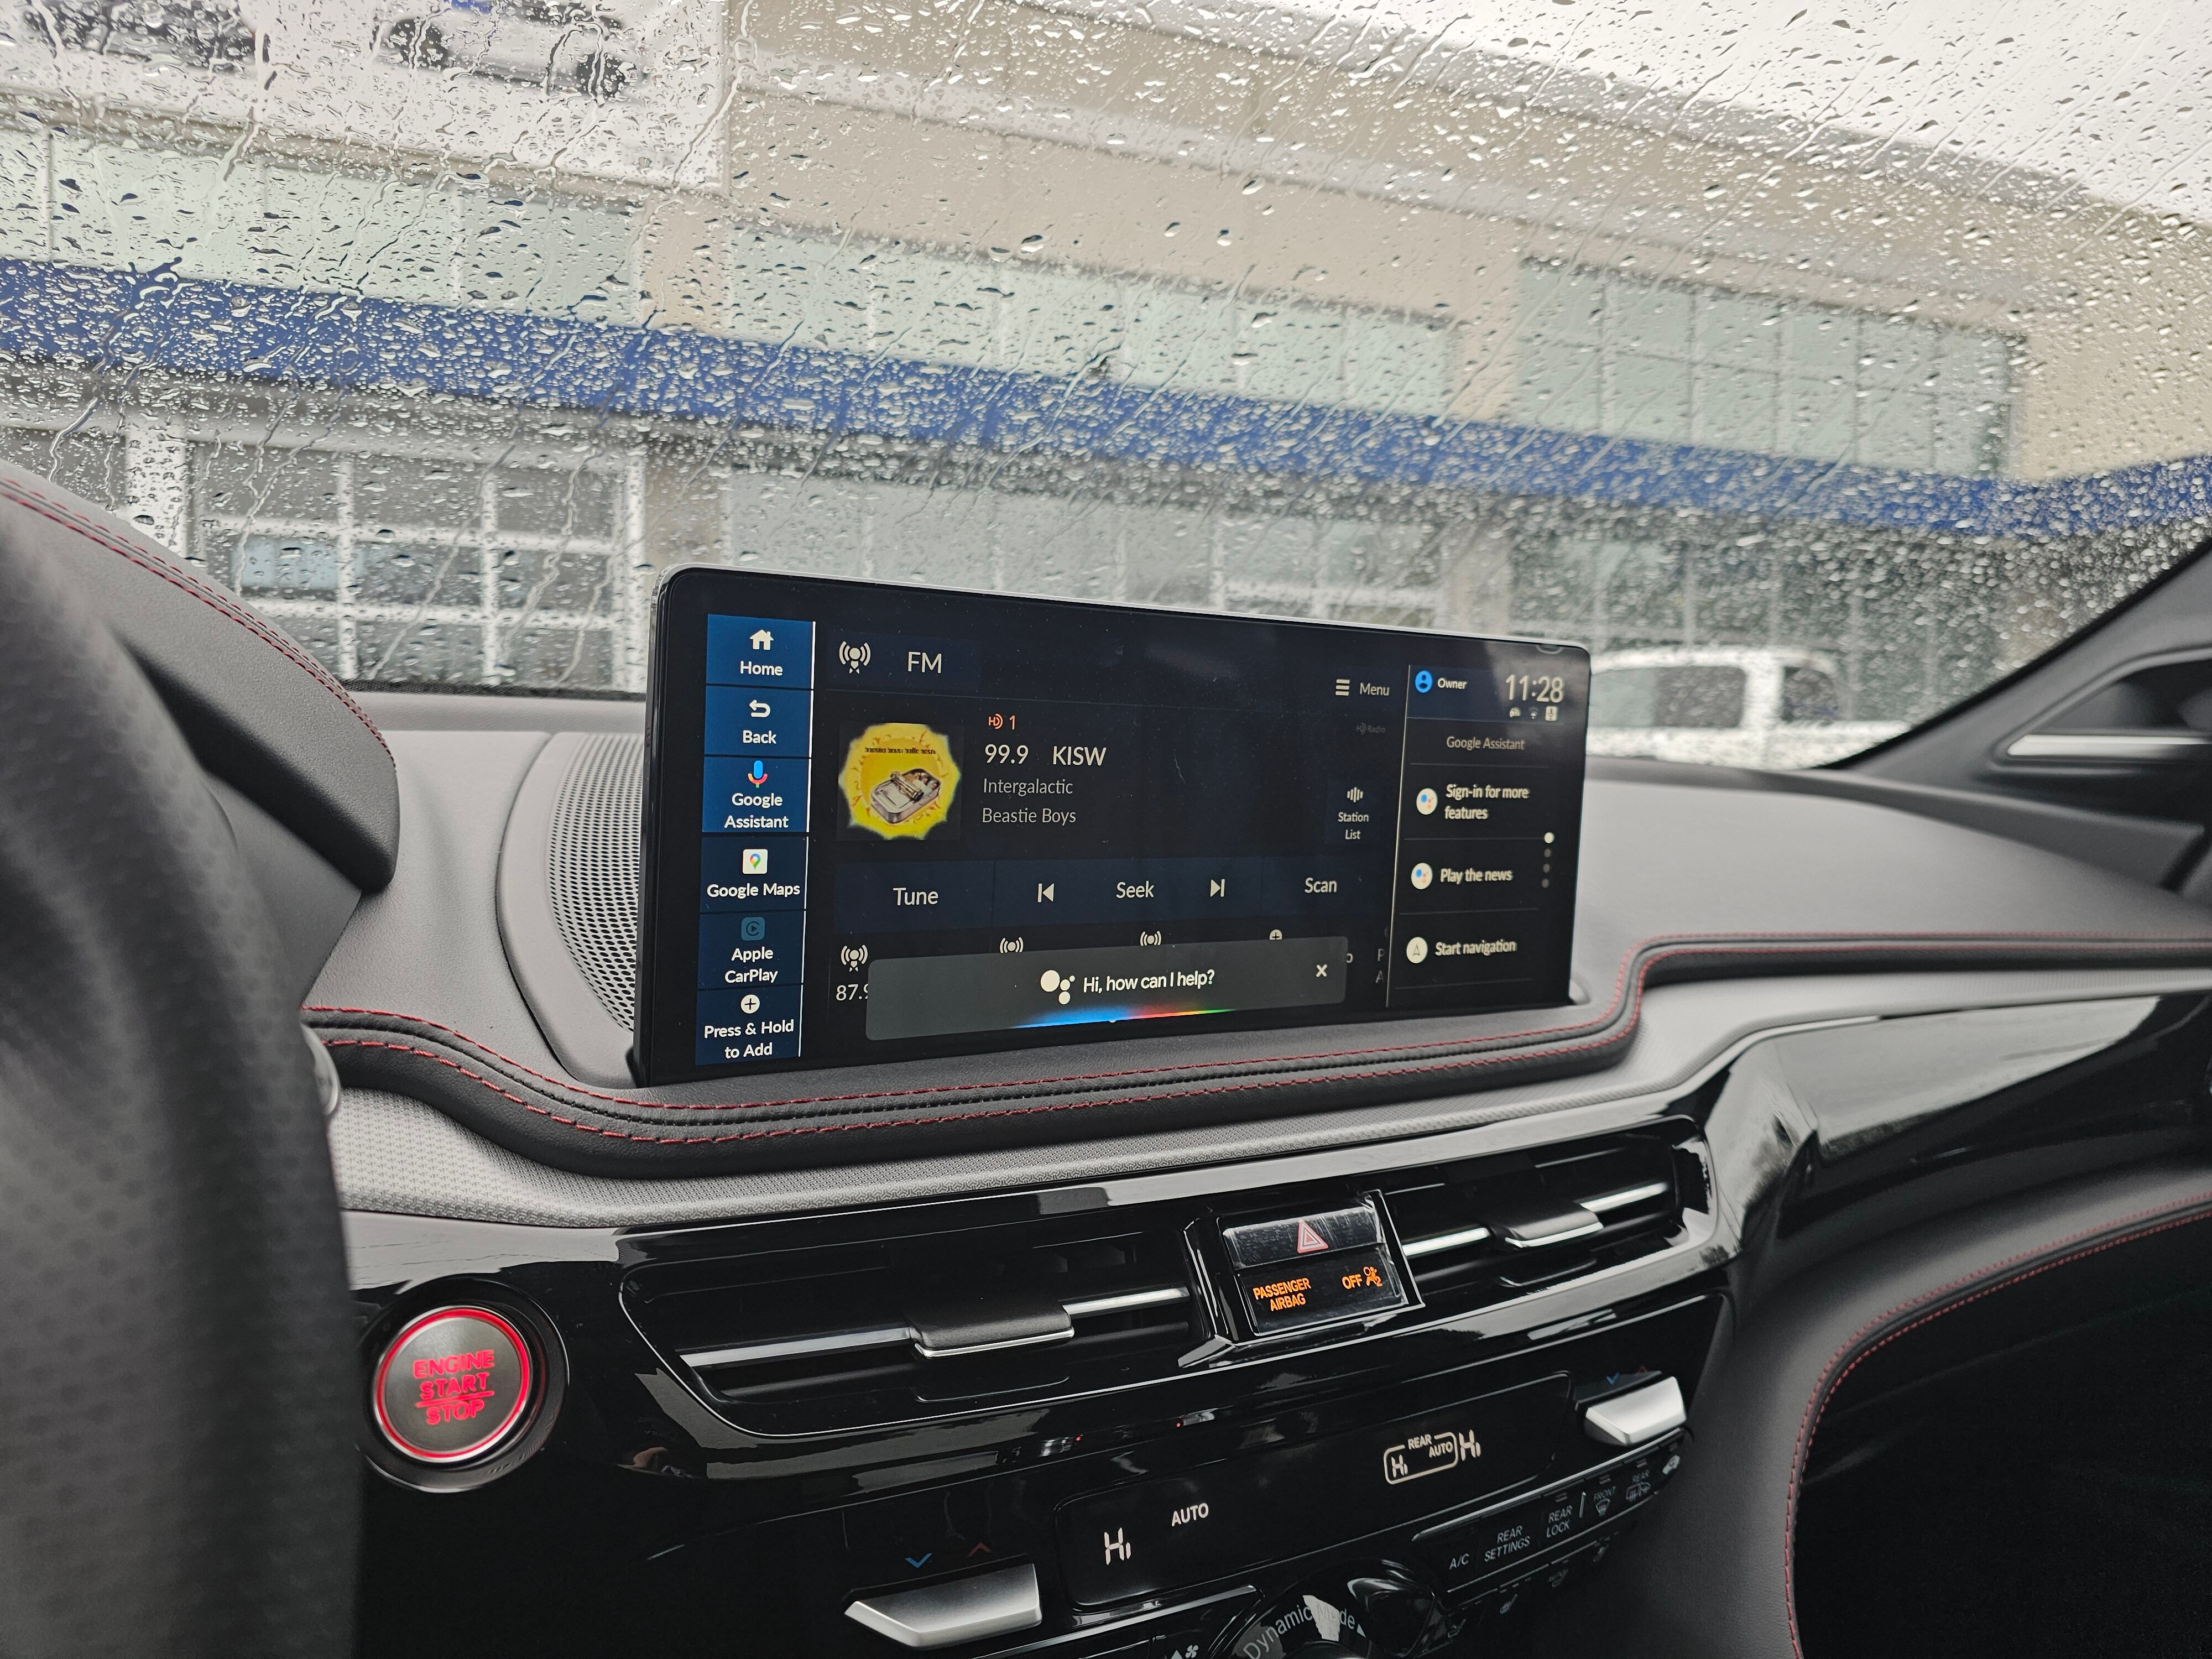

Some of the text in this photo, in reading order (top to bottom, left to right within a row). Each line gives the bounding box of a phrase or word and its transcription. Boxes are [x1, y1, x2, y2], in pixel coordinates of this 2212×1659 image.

[740, 661, 783, 676] Home
[907, 651, 942, 674] FM
[1360, 683, 1389, 696] Menu
[1438, 677, 1467, 690] Owner
[1505, 674, 1564, 703] 11:28
[1009, 715, 1016, 730] 1
[742, 730, 776, 744] Back
[1447, 736, 1525, 750] Google Assistant
[985, 744, 1107, 766] 99.9 KISW
[983, 778, 1073, 797] Intergalactic
[1446, 784, 1530, 800] Sign-in for more
[732, 793, 782, 808] Google
[982, 807, 1076, 826] Beastie Boys
[1338, 812, 1369, 823] Station
[1444, 806, 1489, 820] features
[724, 816, 789, 828] Assistant
[1345, 830, 1361, 840] List
[1441, 868, 1514, 885] Play the news
[707, 883, 800, 899] Google Maps
[1116, 880, 1155, 899] Seek
[1305, 878, 1337, 894] Scan
[893, 886, 939, 906] Tune
[731, 948, 774, 963] Apple
[1435, 939, 1517, 956] Start navigation
[724, 969, 778, 984] CarPlay
[1083, 969, 1215, 994] Hi, how can I help?
[705, 1019, 794, 1039] Press & Hold
[724, 1043, 773, 1058] to Add
[1253, 1277, 1311, 1300] PASSENGER
[1342, 1274, 1363, 1290] OFF
[1270, 1293, 1306, 1311] AIRBAG
[413, 1349, 495, 1379] ENGINE
[420, 1372, 490, 1400] START
[426, 1399, 485, 1425] STOP
[1408, 1434, 1432, 1450] REAR
[1429, 1441, 1453, 1458] AUTO
[1171, 1503, 1209, 1527] AUTO
[1548, 1504, 1573, 1523] REAR
[1496, 1525, 1523, 1543] REAR
[1546, 1520, 1571, 1538] LOCK
[1484, 1536, 1530, 1562] SETTINGS
[1449, 1553, 1469, 1571] A/C
[1243, 1601, 1355, 1659] Dynamic Mode
